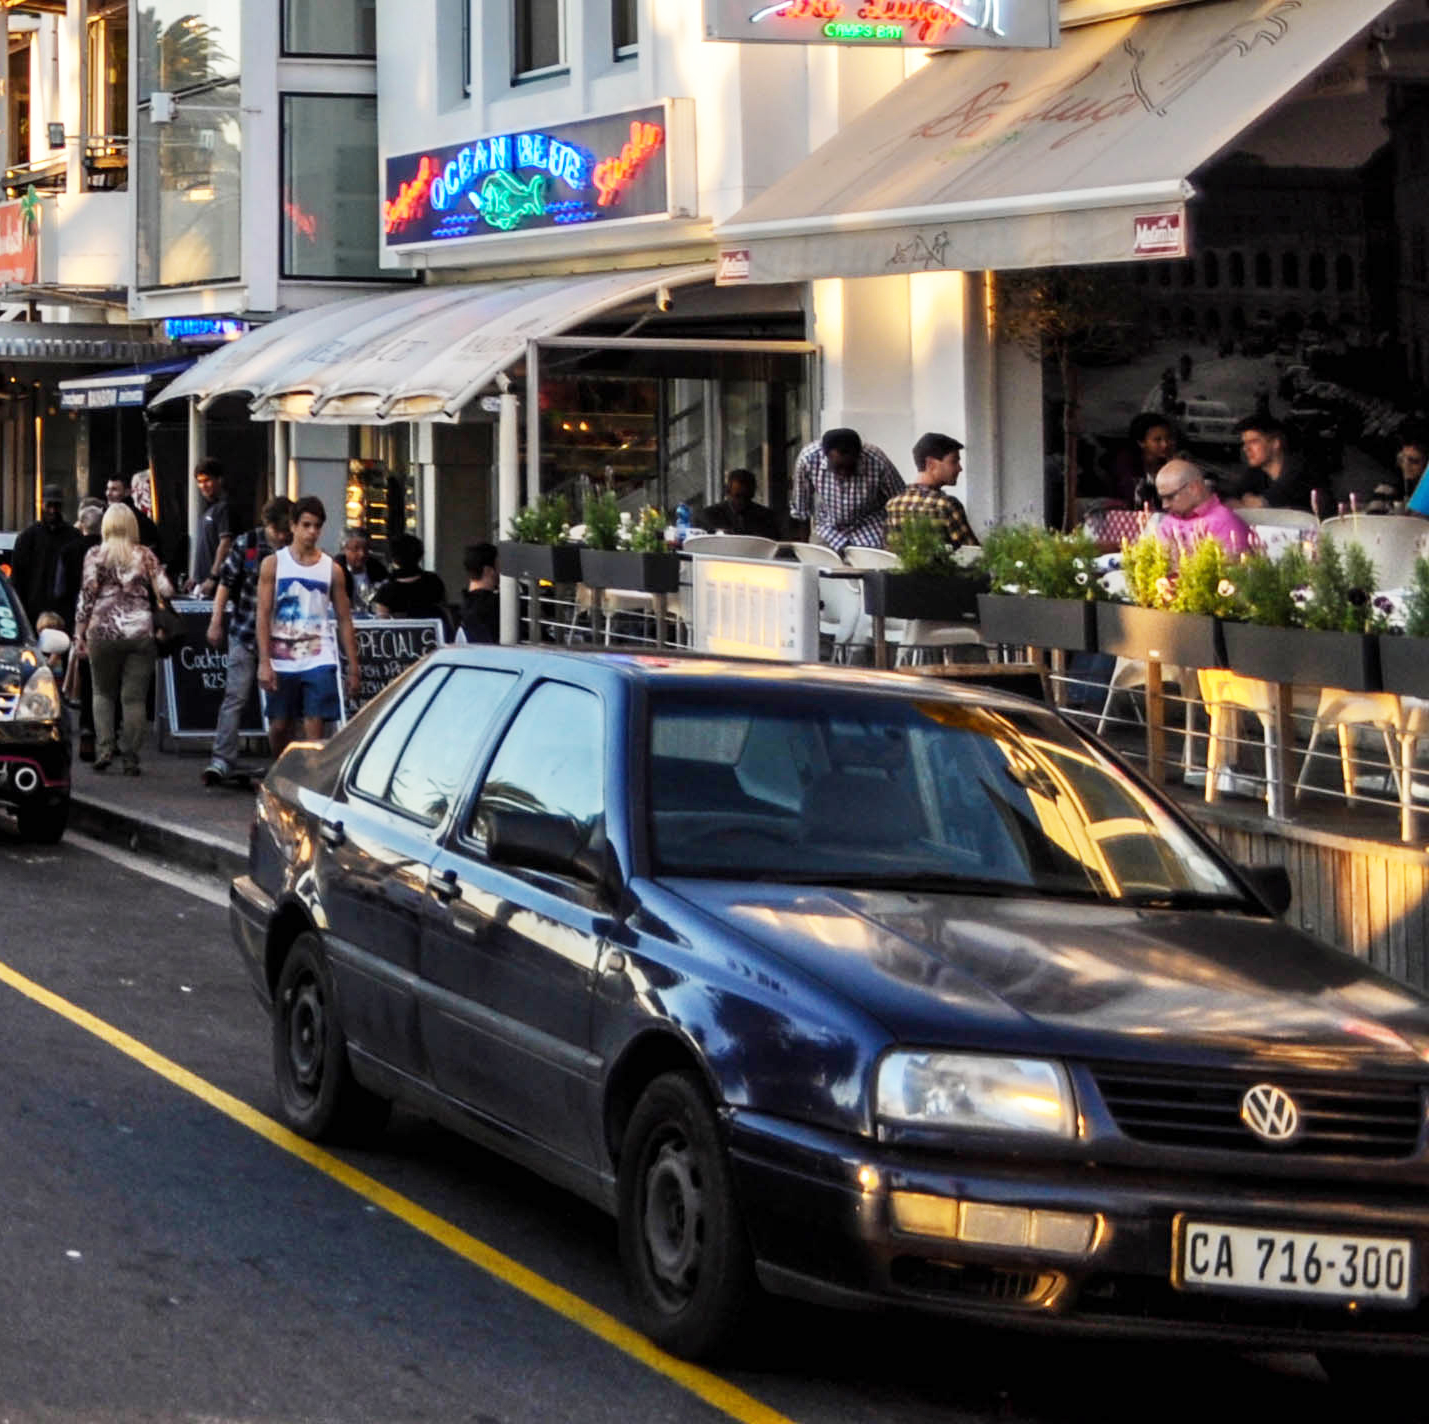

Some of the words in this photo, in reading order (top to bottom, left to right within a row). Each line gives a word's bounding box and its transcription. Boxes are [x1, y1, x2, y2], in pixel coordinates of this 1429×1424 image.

[823, 22, 873, 39] CAMPS
[430, 135, 510, 210] OCEAN
[517, 133, 586, 190] BLUE
[354, 628, 438, 659] PECIALS
[1190, 1231, 1233, 1279] CA
[1256, 1236, 1405, 1291] 716-300
